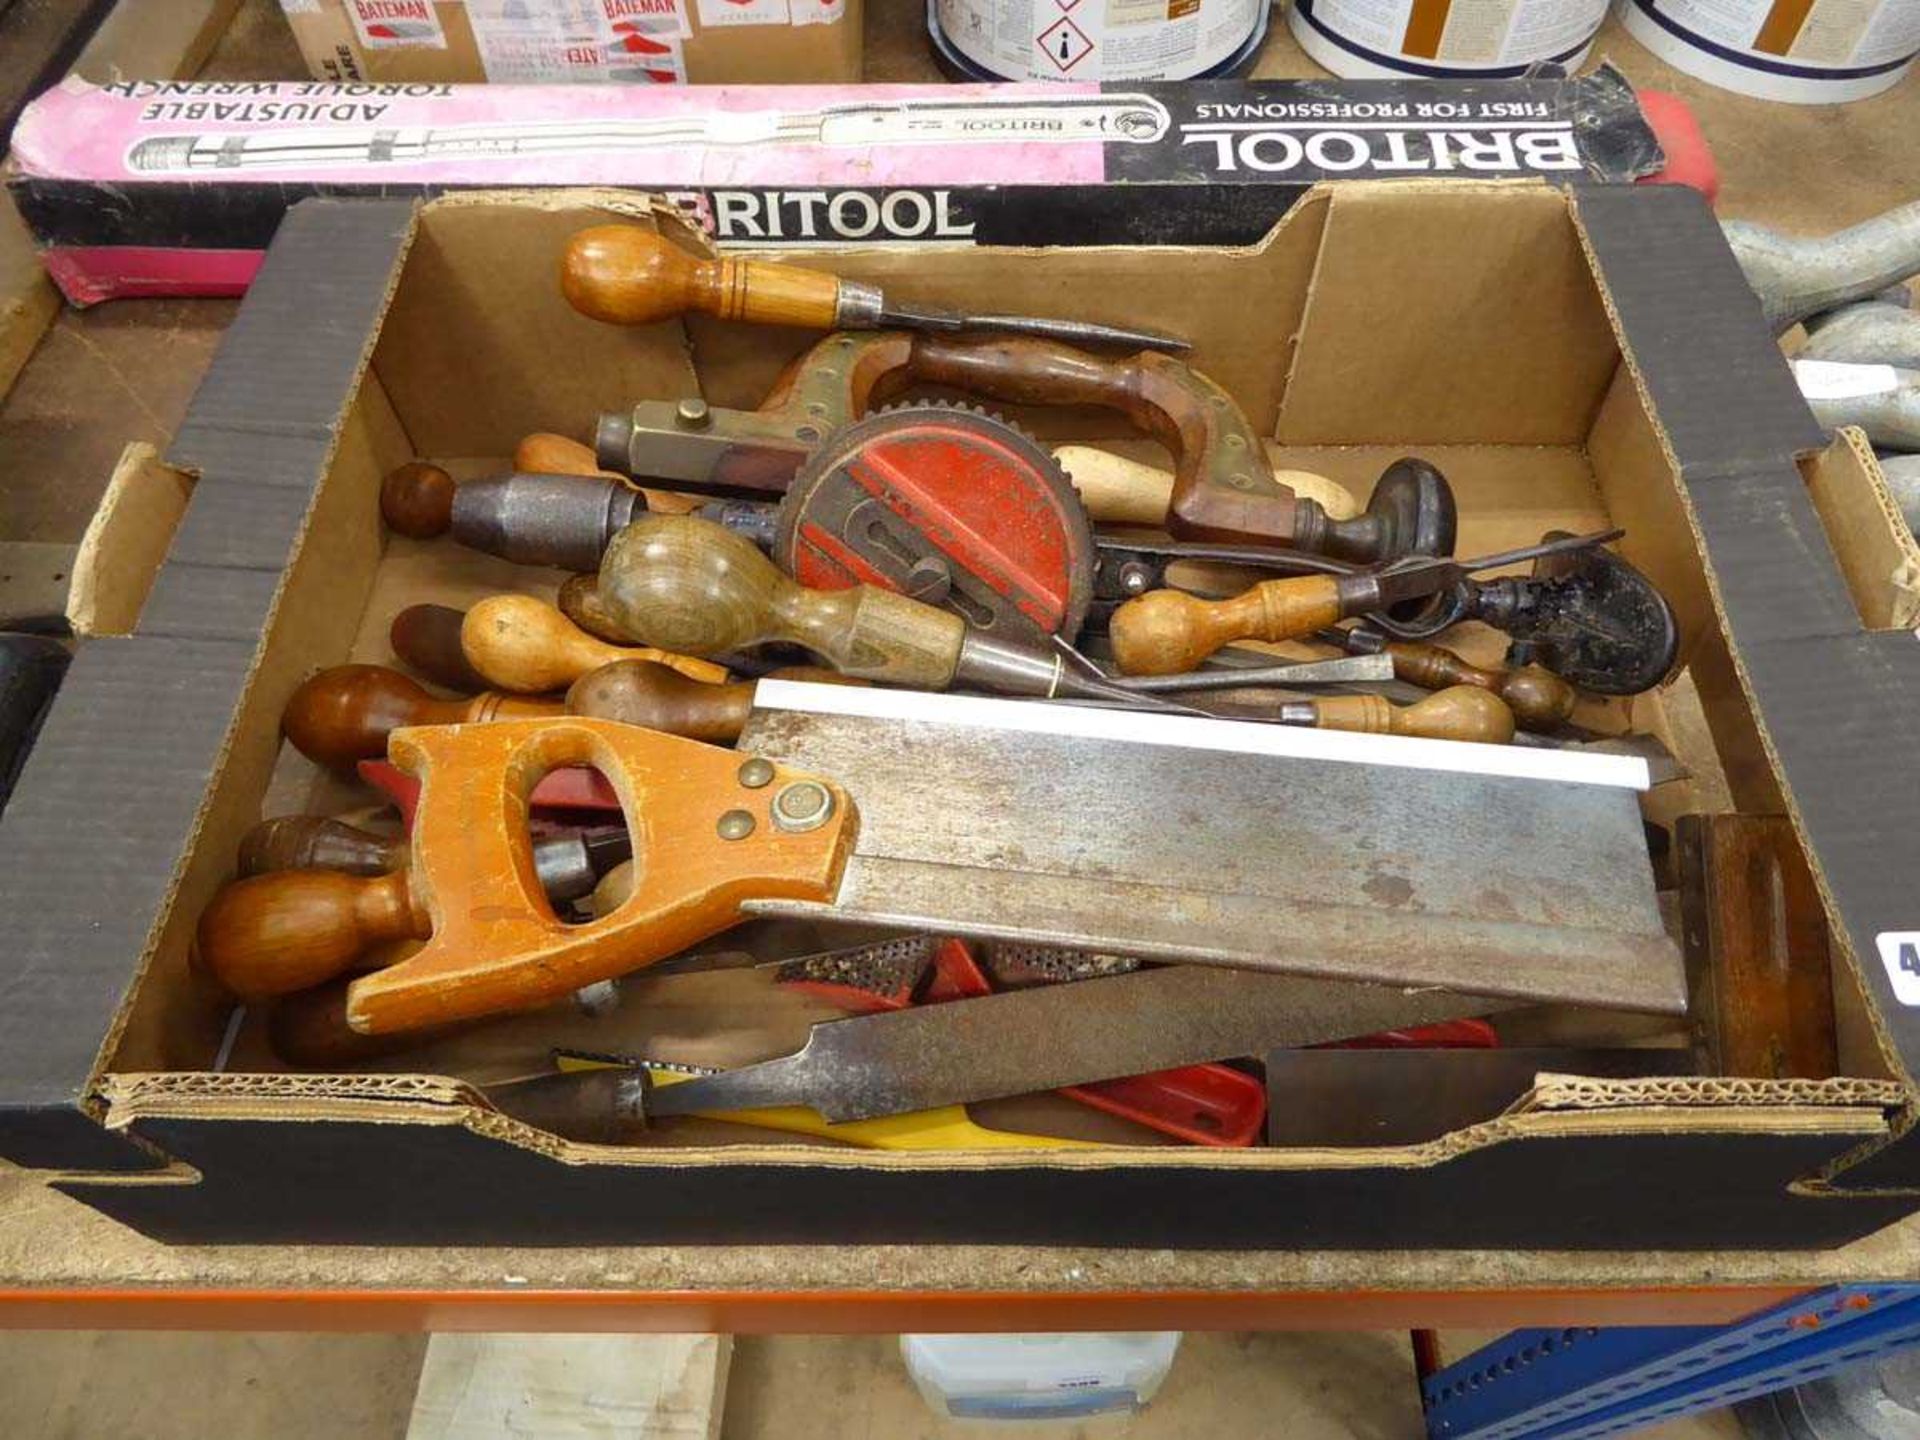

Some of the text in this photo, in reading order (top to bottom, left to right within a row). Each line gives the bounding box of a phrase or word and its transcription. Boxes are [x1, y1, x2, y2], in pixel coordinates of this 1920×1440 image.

[355, 0, 430, 20] BATEMAN
[603, 0, 677, 19] BATEMAN
[102, 82, 454, 98] TORQUE WRENCH
[143, 102, 388, 121] ADJUSTABLE
[1195, 102, 1549, 118] FIRST FOR PROFESSIONALS
[962, 117, 1064, 132] BRITOOL
[1182, 131, 1585, 172] BRITOOL
